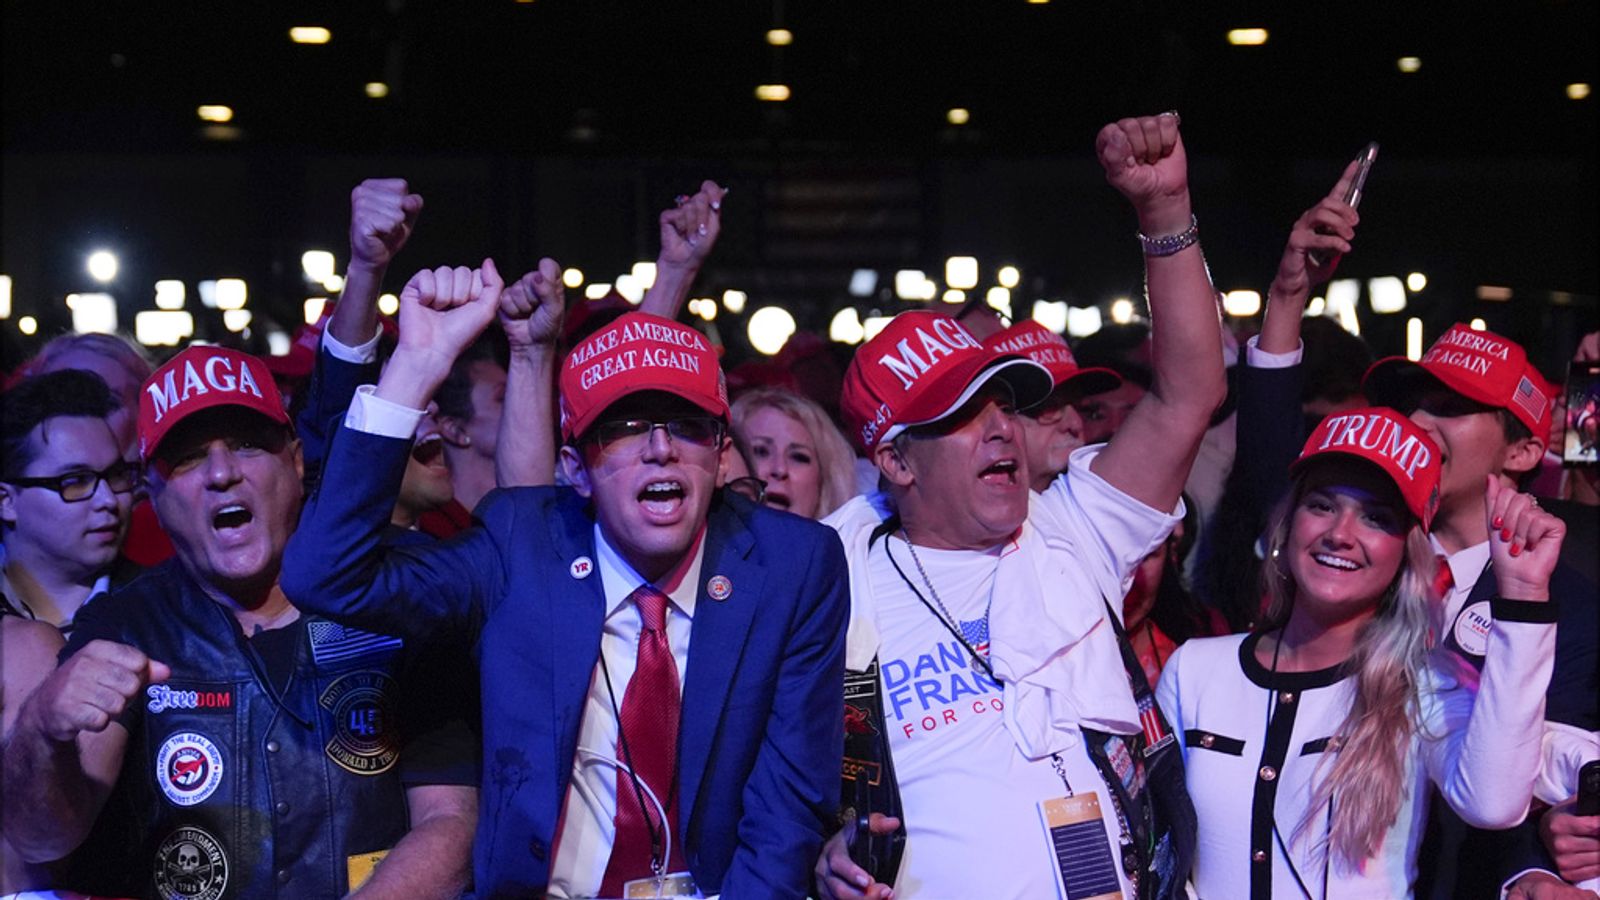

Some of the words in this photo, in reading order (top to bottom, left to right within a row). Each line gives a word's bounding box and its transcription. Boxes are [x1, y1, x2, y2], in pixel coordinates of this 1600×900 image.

[570, 329, 619, 369] MAKE
[621, 321, 707, 352] AMERICA
[992, 332, 1036, 353] MAKE
[1437, 350, 1493, 376] AGAIN
[147, 356, 263, 423] MAGA
[580, 350, 637, 390] GREAT
[641, 348, 700, 375] AGAIN
[1318, 414, 1431, 481] TRUMP
[881, 641, 967, 690] DAN
[888, 671, 1004, 721] FRAN
[903, 709, 957, 738] FOR
[972, 698, 1004, 714] CO
[187, 735, 206, 747] REAL
[330, 743, 368, 769] DONALD
[369, 757, 377, 770] J
